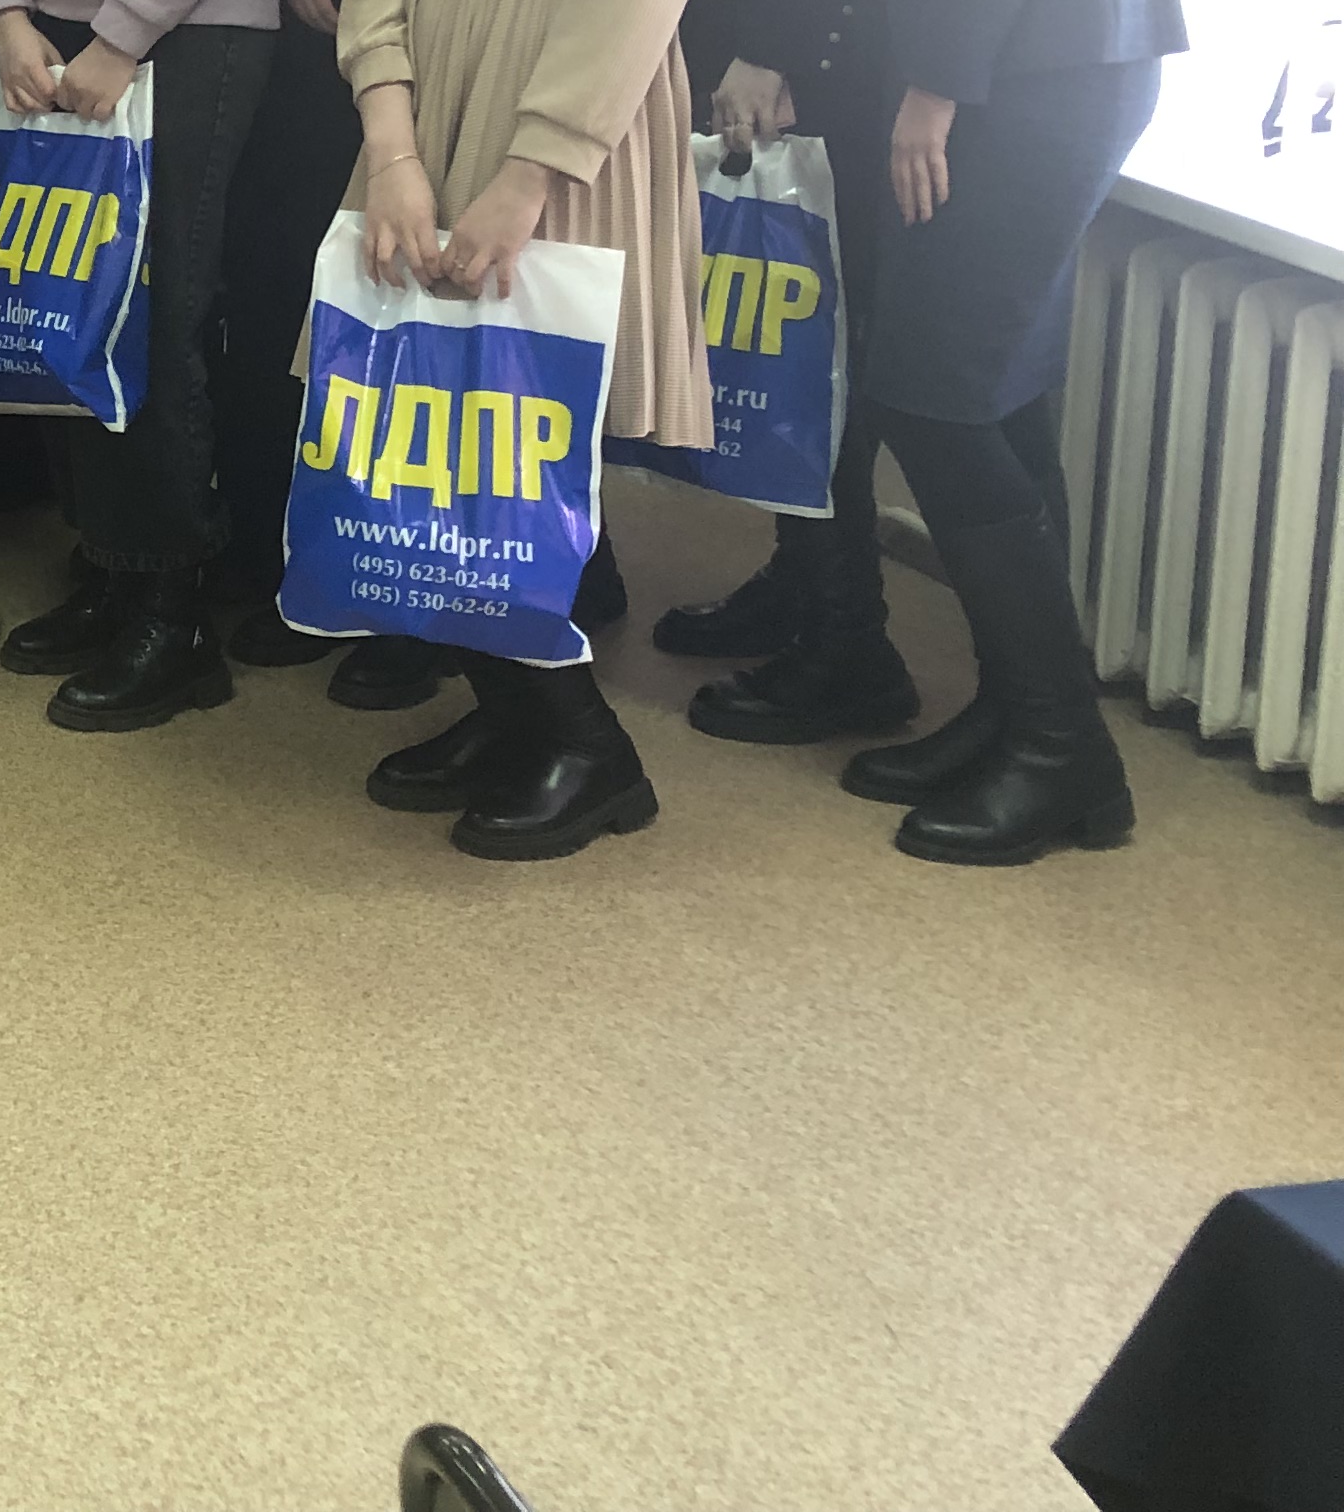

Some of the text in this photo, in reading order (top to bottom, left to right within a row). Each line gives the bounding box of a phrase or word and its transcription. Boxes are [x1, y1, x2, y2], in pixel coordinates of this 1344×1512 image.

[302, 373, 573, 510] ЛДПР
[334, 516, 534, 566] www.ldpr.ru
[352, 552, 511, 592] (495) 623-02-44
[351, 580, 509, 619] (495) 530-62-62
